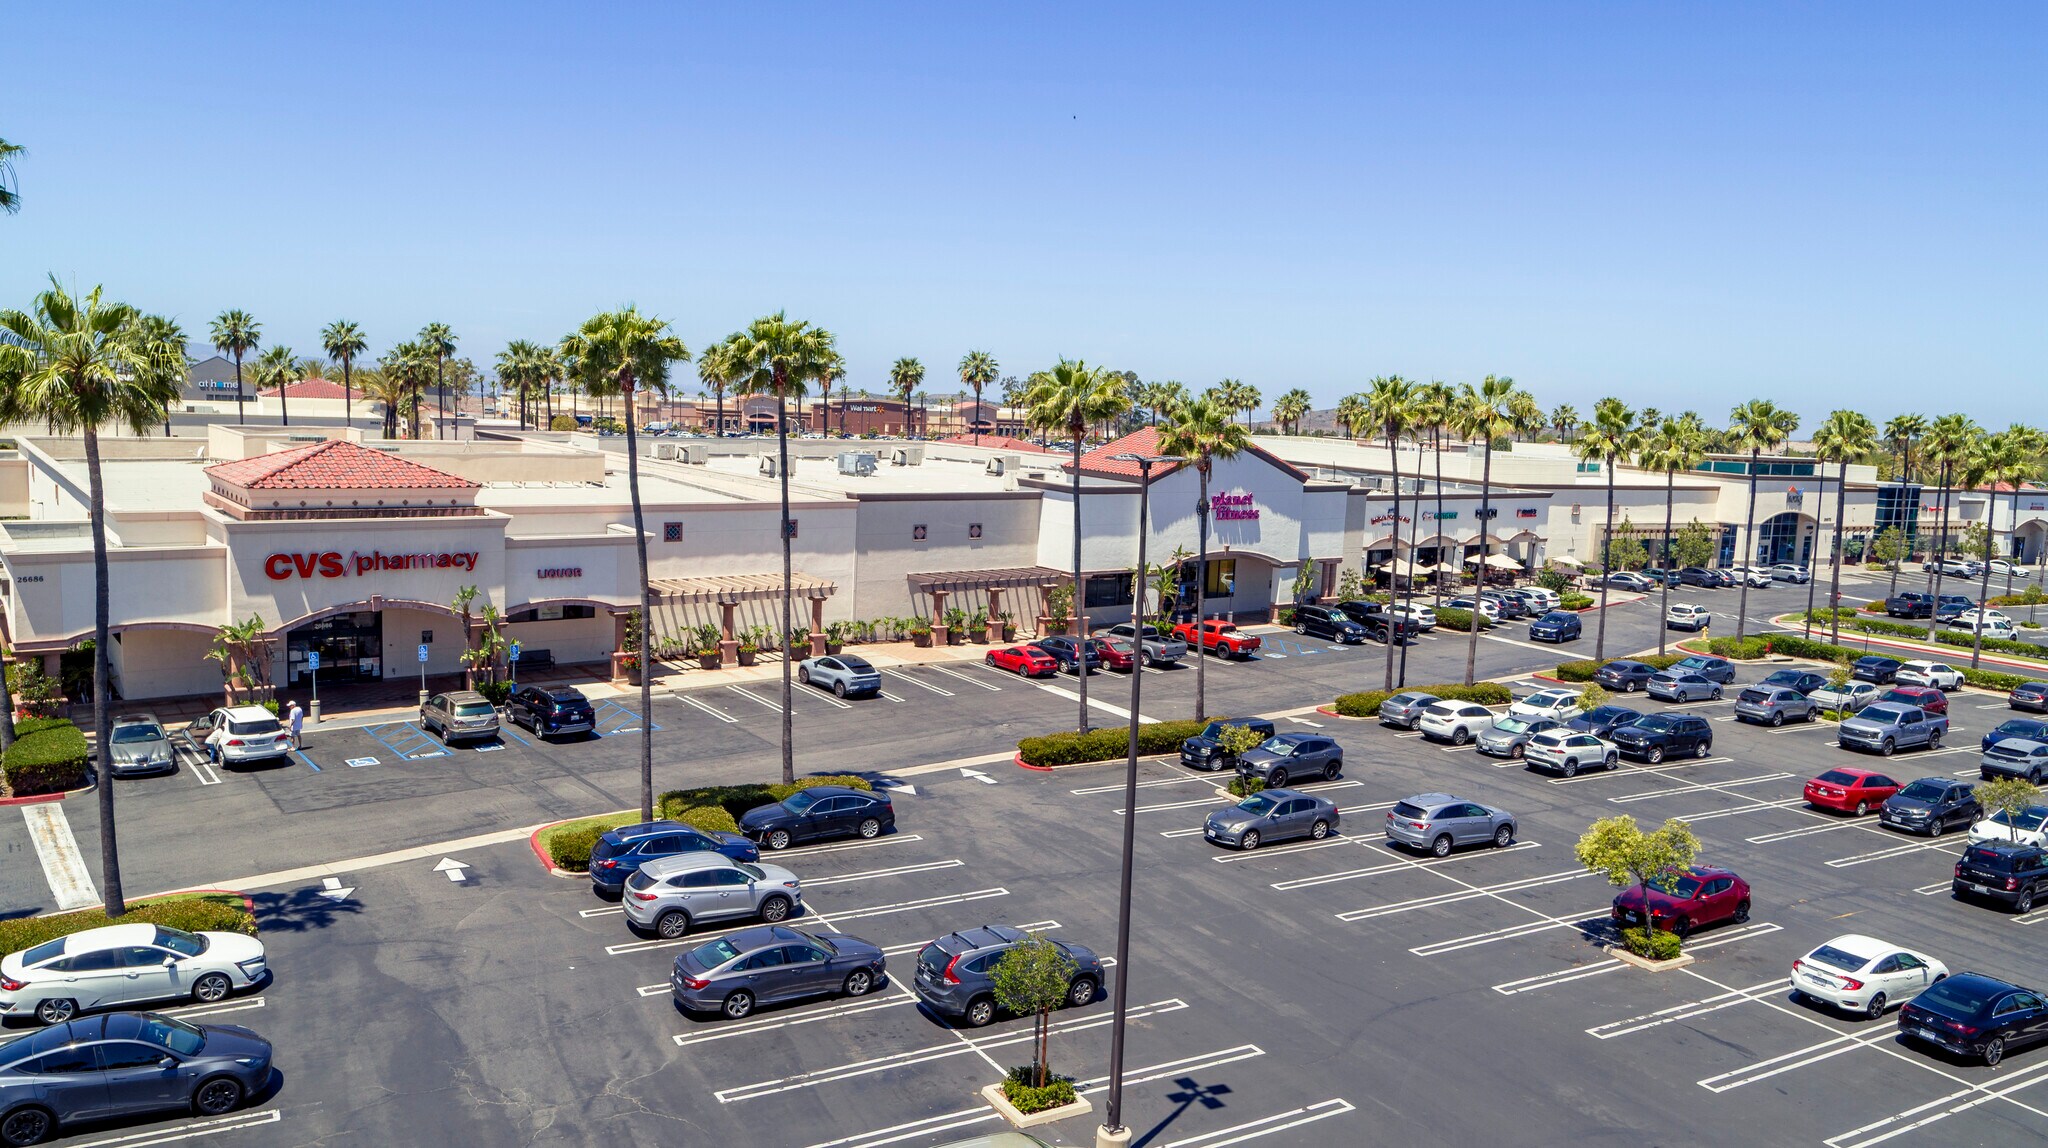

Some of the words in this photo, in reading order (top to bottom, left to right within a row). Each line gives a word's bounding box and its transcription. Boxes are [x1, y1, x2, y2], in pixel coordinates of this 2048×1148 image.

[198, 380, 209, 388] at
[1211, 491, 1253, 509] planet
[1216, 506, 1260, 520] fitness
[17, 575, 44, 583] 26686
[537, 567, 583, 579] LIQUOR
